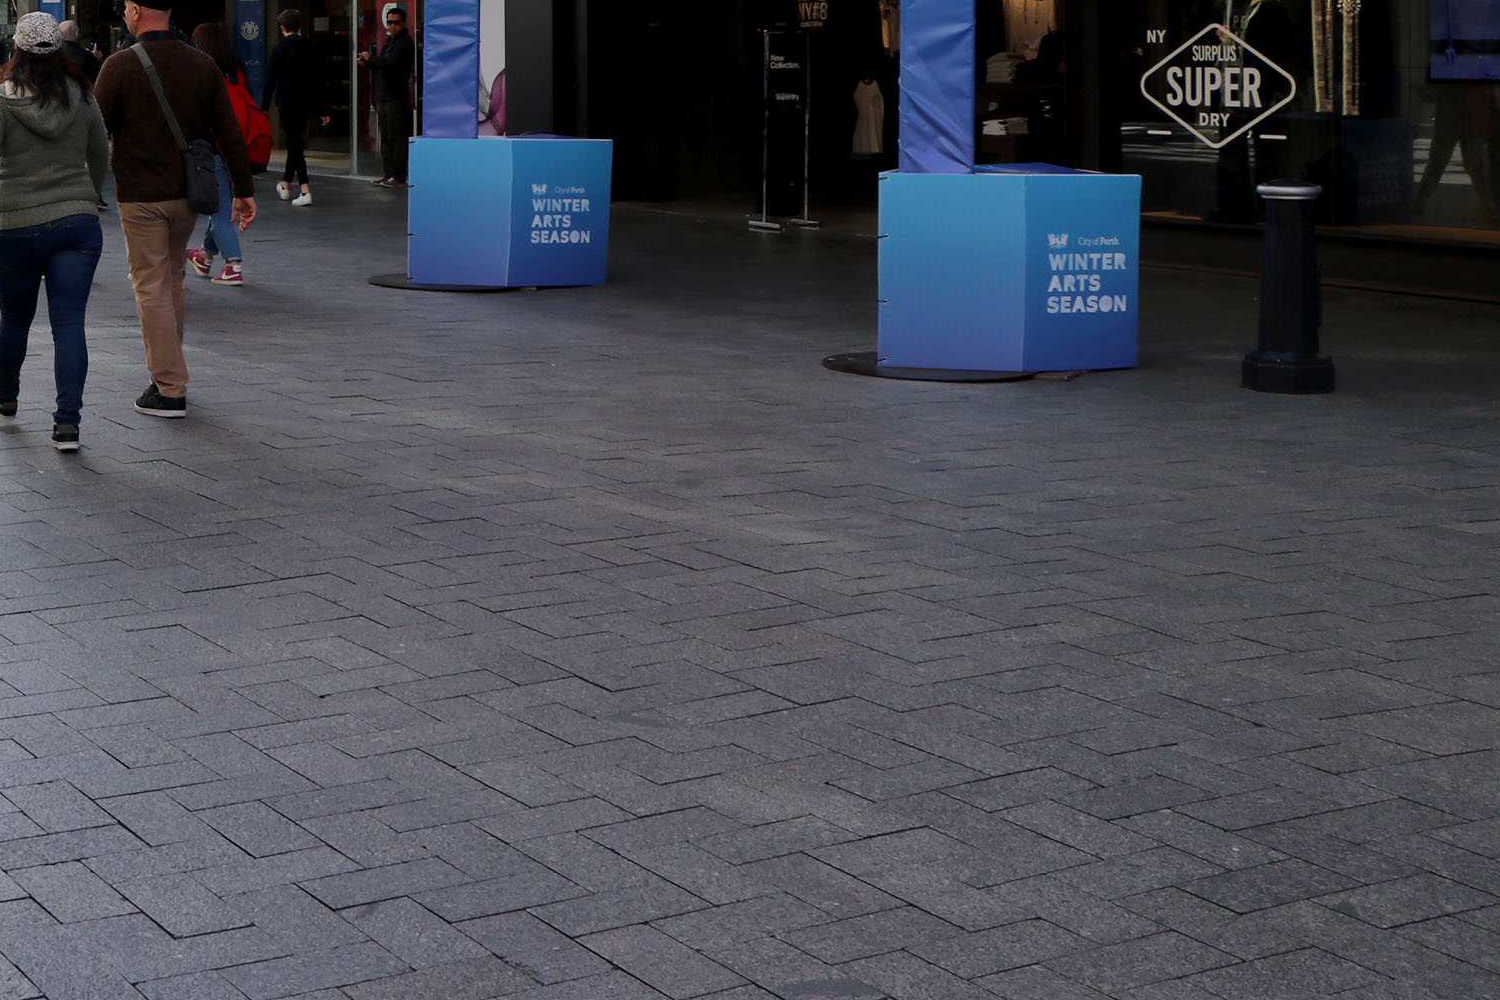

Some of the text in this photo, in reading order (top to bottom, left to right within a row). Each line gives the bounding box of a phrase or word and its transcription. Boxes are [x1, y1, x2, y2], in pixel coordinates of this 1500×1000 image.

[1147, 29, 1166, 43] NY
[1192, 45, 1237, 62] SURPLUS
[1166, 66, 1262, 108] SUPER
[1199, 113, 1230, 127] DRY
[532, 198, 590, 212] WINTER
[532, 214, 571, 228] ARTS
[531, 230, 590, 244] SEASON
[1100, 236, 1119, 245] Perth
[1048, 252, 1126, 271] WINTER
[1048, 274, 1100, 292] ARTS
[1047, 295, 1127, 313] SEASON
